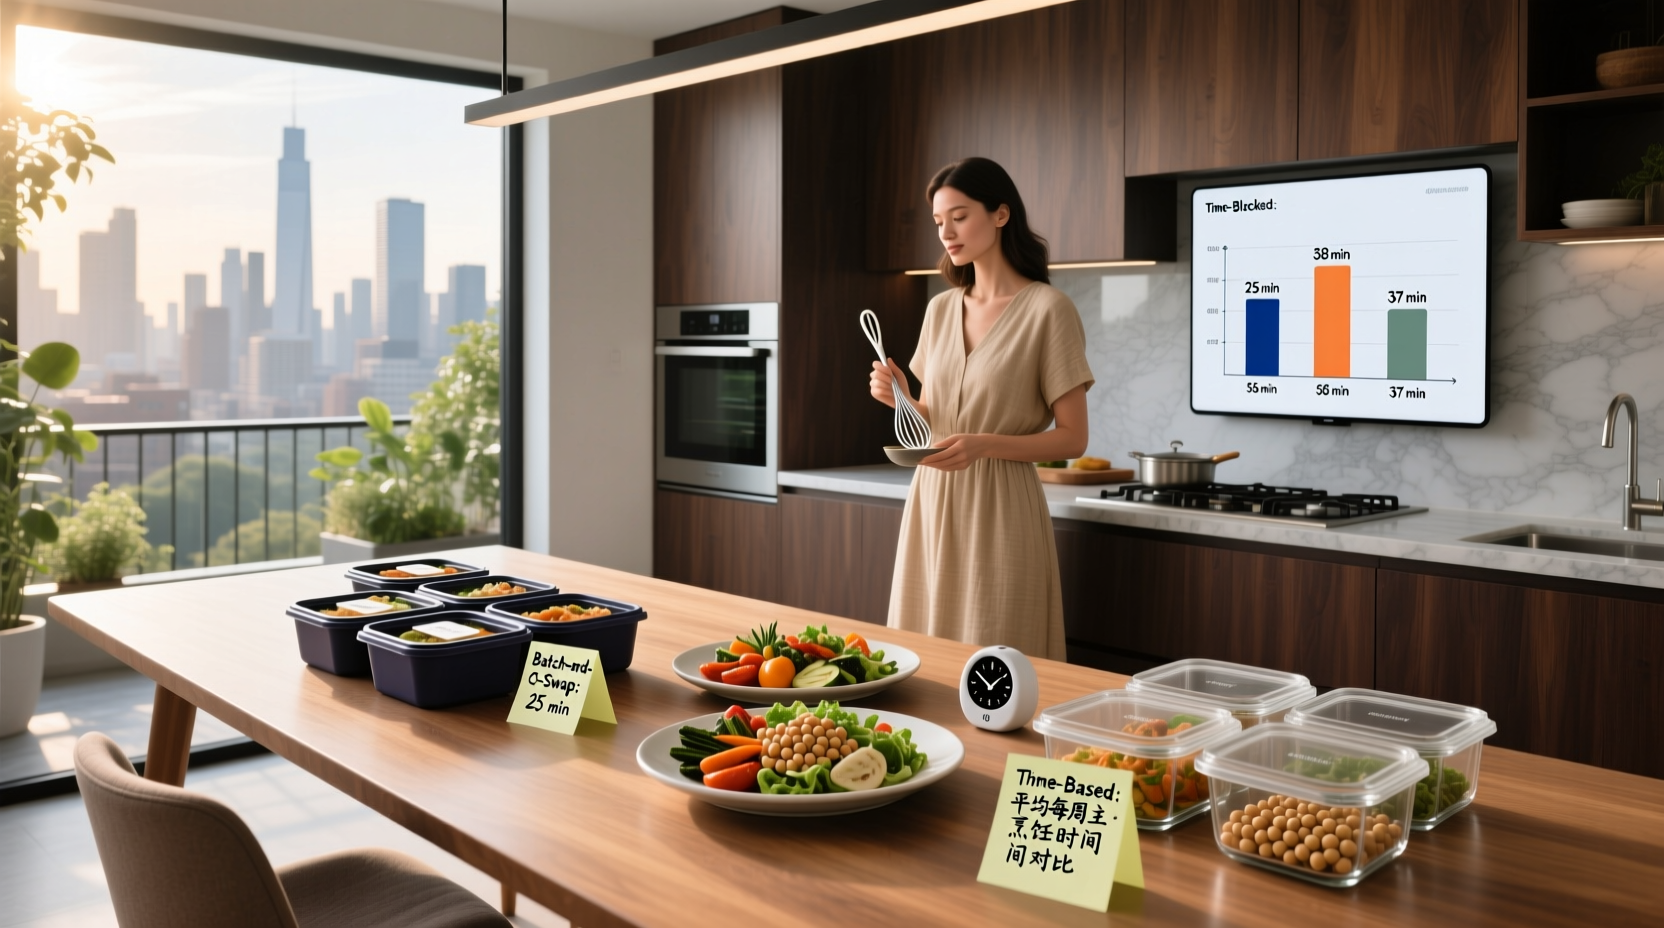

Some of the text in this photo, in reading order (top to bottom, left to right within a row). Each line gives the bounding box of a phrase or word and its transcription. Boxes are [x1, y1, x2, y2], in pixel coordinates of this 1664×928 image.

[1313, 247, 1351, 260] 38 min
[1244, 281, 1280, 294] 25 min
[1387, 291, 1427, 304] 37 min
[1260, 383, 1277, 394] min
[1315, 384, 1350, 396] 56 min
[1388, 386, 1426, 399] 37 min
[525, 692, 570, 716] 25 min
[1006, 842, 1074, 874] 间对比
